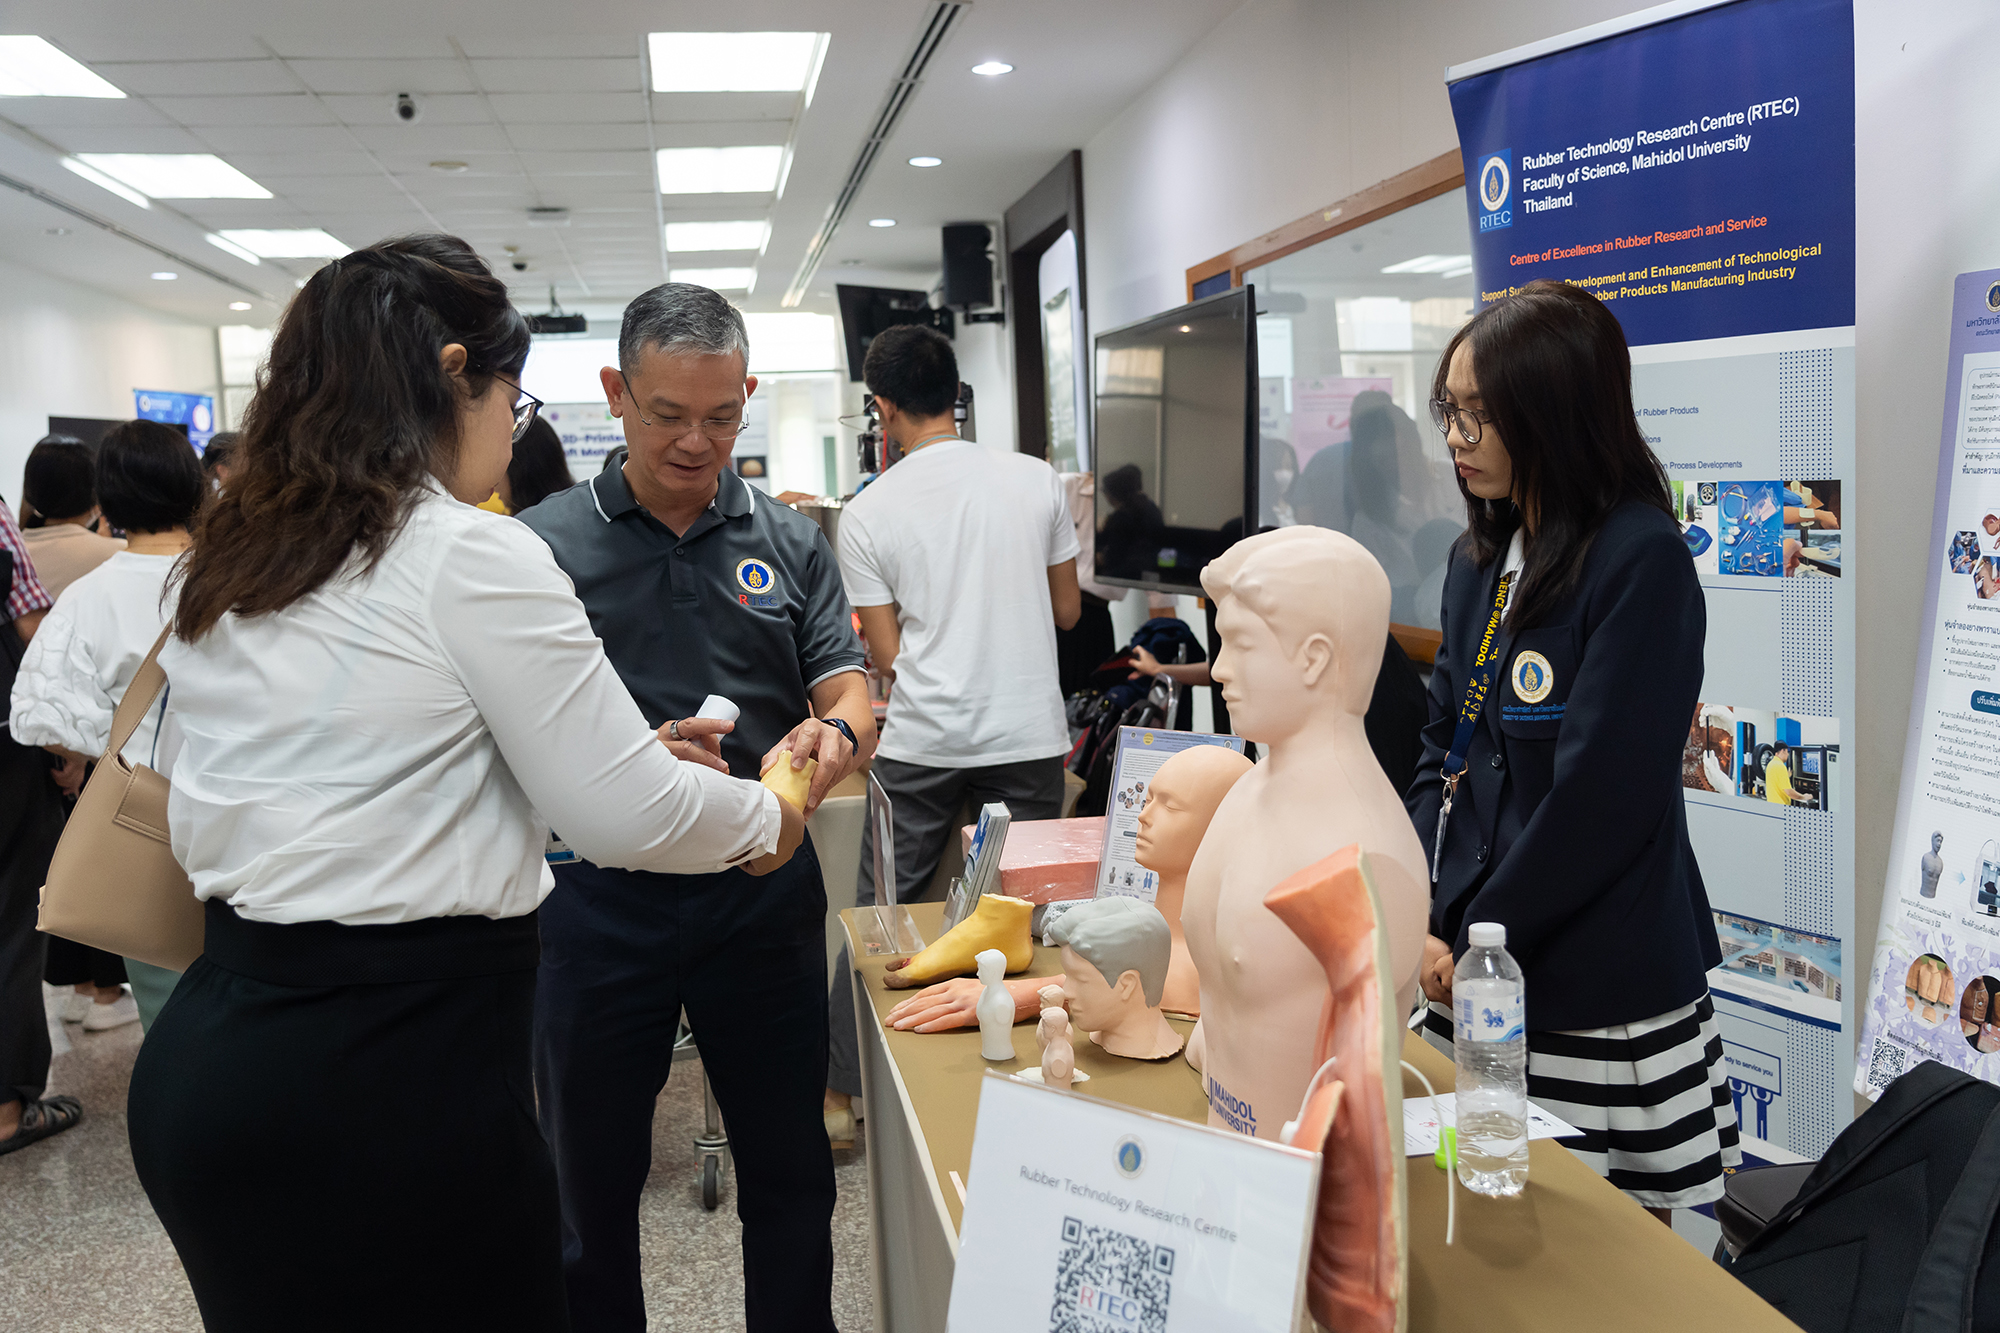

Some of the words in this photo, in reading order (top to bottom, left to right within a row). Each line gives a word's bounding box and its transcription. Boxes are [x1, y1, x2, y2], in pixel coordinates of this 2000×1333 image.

[1522, 152, 1565, 171] Rubber
[1566, 136, 1634, 161] Technology
[1636, 119, 1698, 146] Research
[1700, 111, 1745, 132] Centre
[1747, 96, 1800, 126] (RTEC)
[1522, 173, 1565, 193] Faculty
[1566, 168, 1580, 184] of
[1581, 163, 1630, 182] Science,
[1631, 146, 1685, 170] Mahidol
[1687, 133, 1751, 160] University
[1480, 210, 1511, 230] RTEC
[1522, 191, 1573, 214] Thailand
[1510, 252, 1540, 266] Centre
[1541, 249, 1552, 261] of
[1552, 243, 1603, 260] Excellence
[1604, 239, 1613, 252] in
[1614, 235, 1652, 250] Rubber
[1654, 225, 1704, 244] Research
[1705, 220, 1725, 236] and
[1726, 215, 1767, 232] Service
[1481, 288, 1507, 302] Support
[1565, 271, 1626, 288] Development
[1628, 268, 1647, 280] and
[1650, 257, 1722, 278] Enhancement
[1724, 254, 1736, 268] of
[1738, 243, 1822, 266] Technological
[1591, 289, 1618, 302] ubber
[1620, 283, 1668, 298] Products
[1671, 273, 1745, 292] Manufacturing
[1747, 266, 1796, 282] Industry
[1635, 409, 1642, 417] of
[1643, 408, 1668, 416] Rubber
[1669, 406, 1699, 415] Products
[1669, 461, 1696, 470] Process
[1697, 460, 1743, 470] Developments
[738, 594, 778, 607] RTEC
[1495, 575, 1510, 610] CIENCE
[1475, 610, 1501, 667] @MAHIDOL
[1742, 1062, 1761, 1072] service
[1762, 1069, 1773, 1077] you
[1213, 1100, 1257, 1136] UNIVERSITY
[1214, 1080, 1256, 1122] MAHIDOL
[1020, 1165, 1060, 1189] Rubber
[1064, 1177, 1131, 1212] Technology
[1134, 1199, 1191, 1229] Research
[1194, 1217, 1238, 1242] Centre
[1080, 1285, 1139, 1323] RTEC
